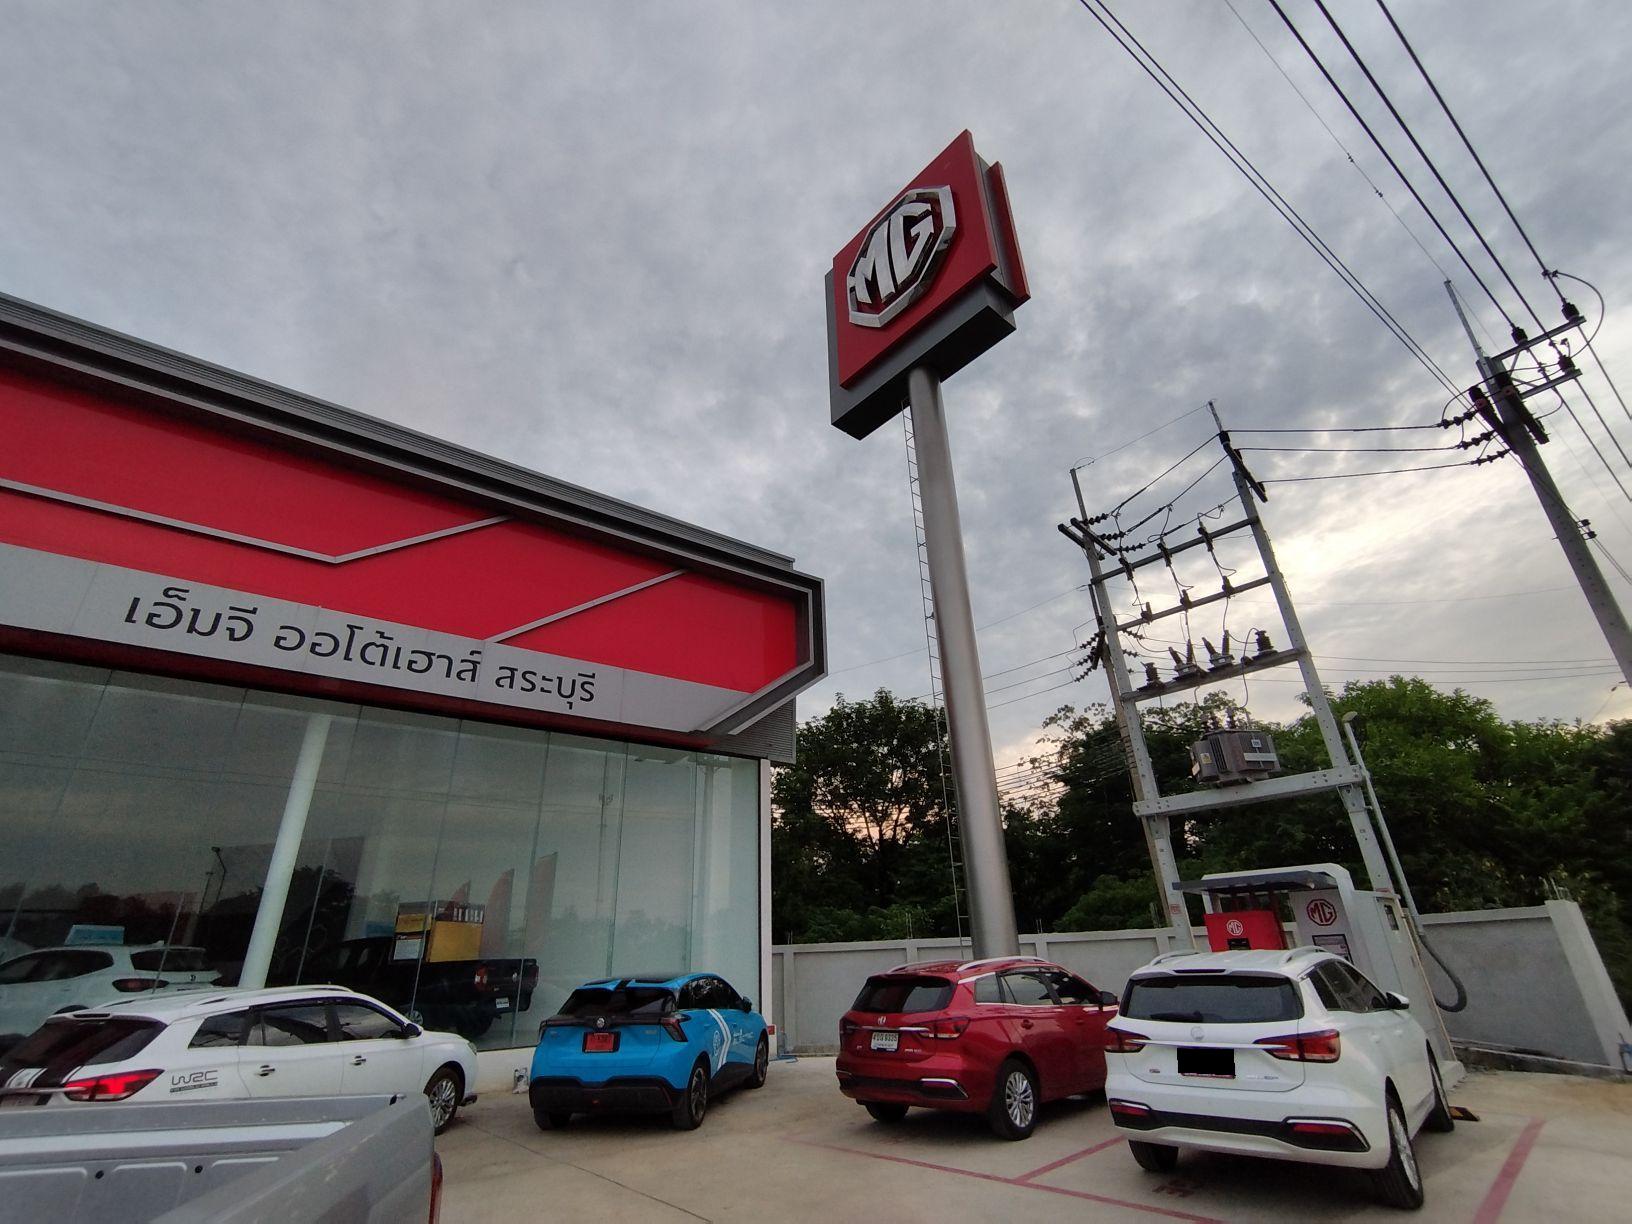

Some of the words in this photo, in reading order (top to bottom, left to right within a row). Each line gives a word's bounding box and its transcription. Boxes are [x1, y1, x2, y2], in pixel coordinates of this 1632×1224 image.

[853, 201, 935, 304] MG
[123, 586, 259, 642] เอ็มจี
[273, 623, 483, 683] ออโต้เฮาส์
[494, 665, 597, 710] สระบุรี
[1309, 900, 1335, 925] MG
[1227, 920, 1243, 935] MG
[171, 1069, 218, 1086] WRC
